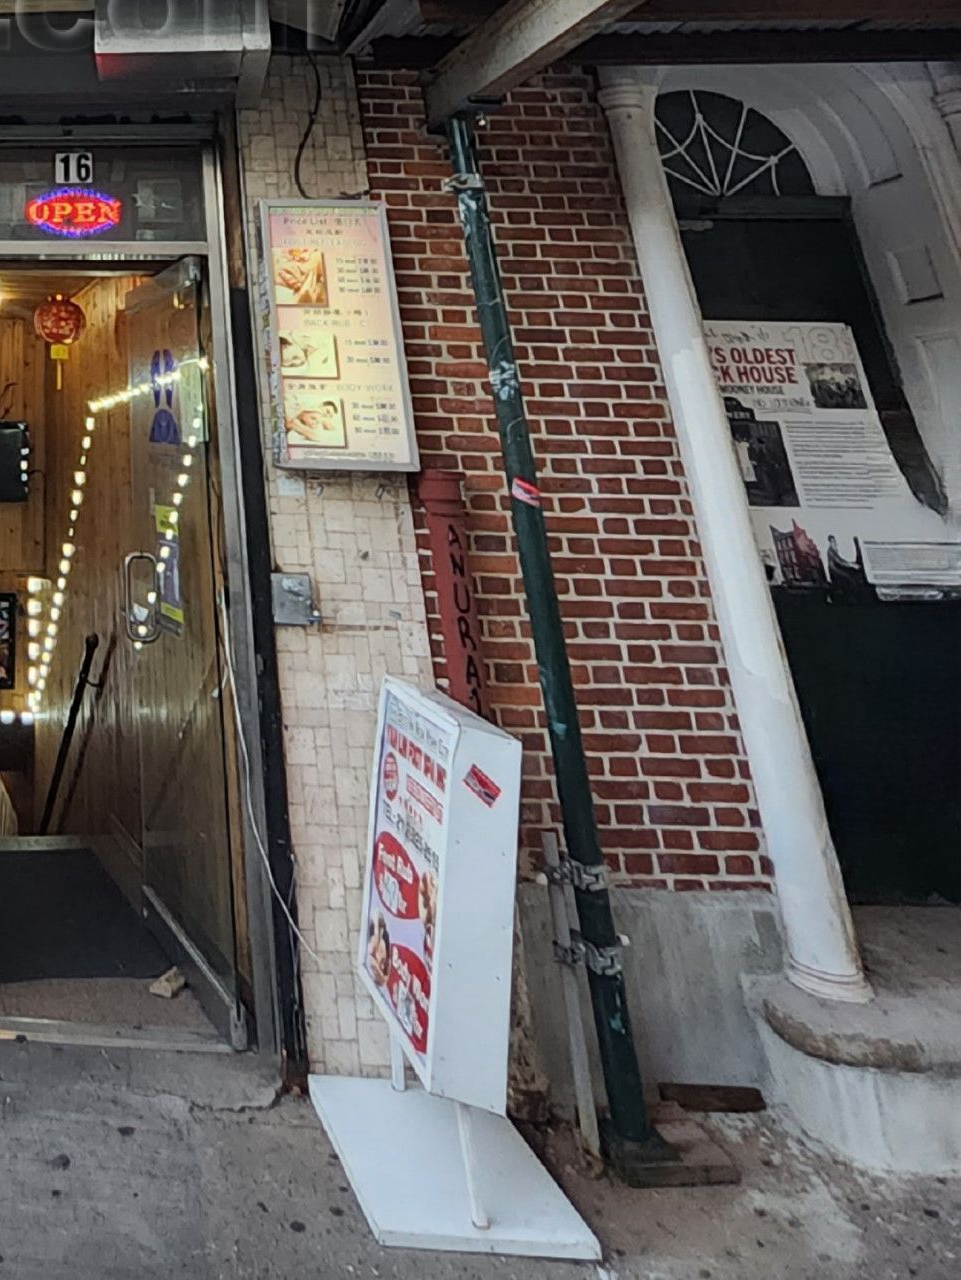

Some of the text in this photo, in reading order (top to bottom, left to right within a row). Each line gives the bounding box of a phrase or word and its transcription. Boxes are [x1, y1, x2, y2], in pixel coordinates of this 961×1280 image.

[59, 154, 92, 183] 16
[28, 200, 121, 225] OPEN
[730, 348, 795, 365] OLDEST
[738, 366, 798, 384] HOUSE
